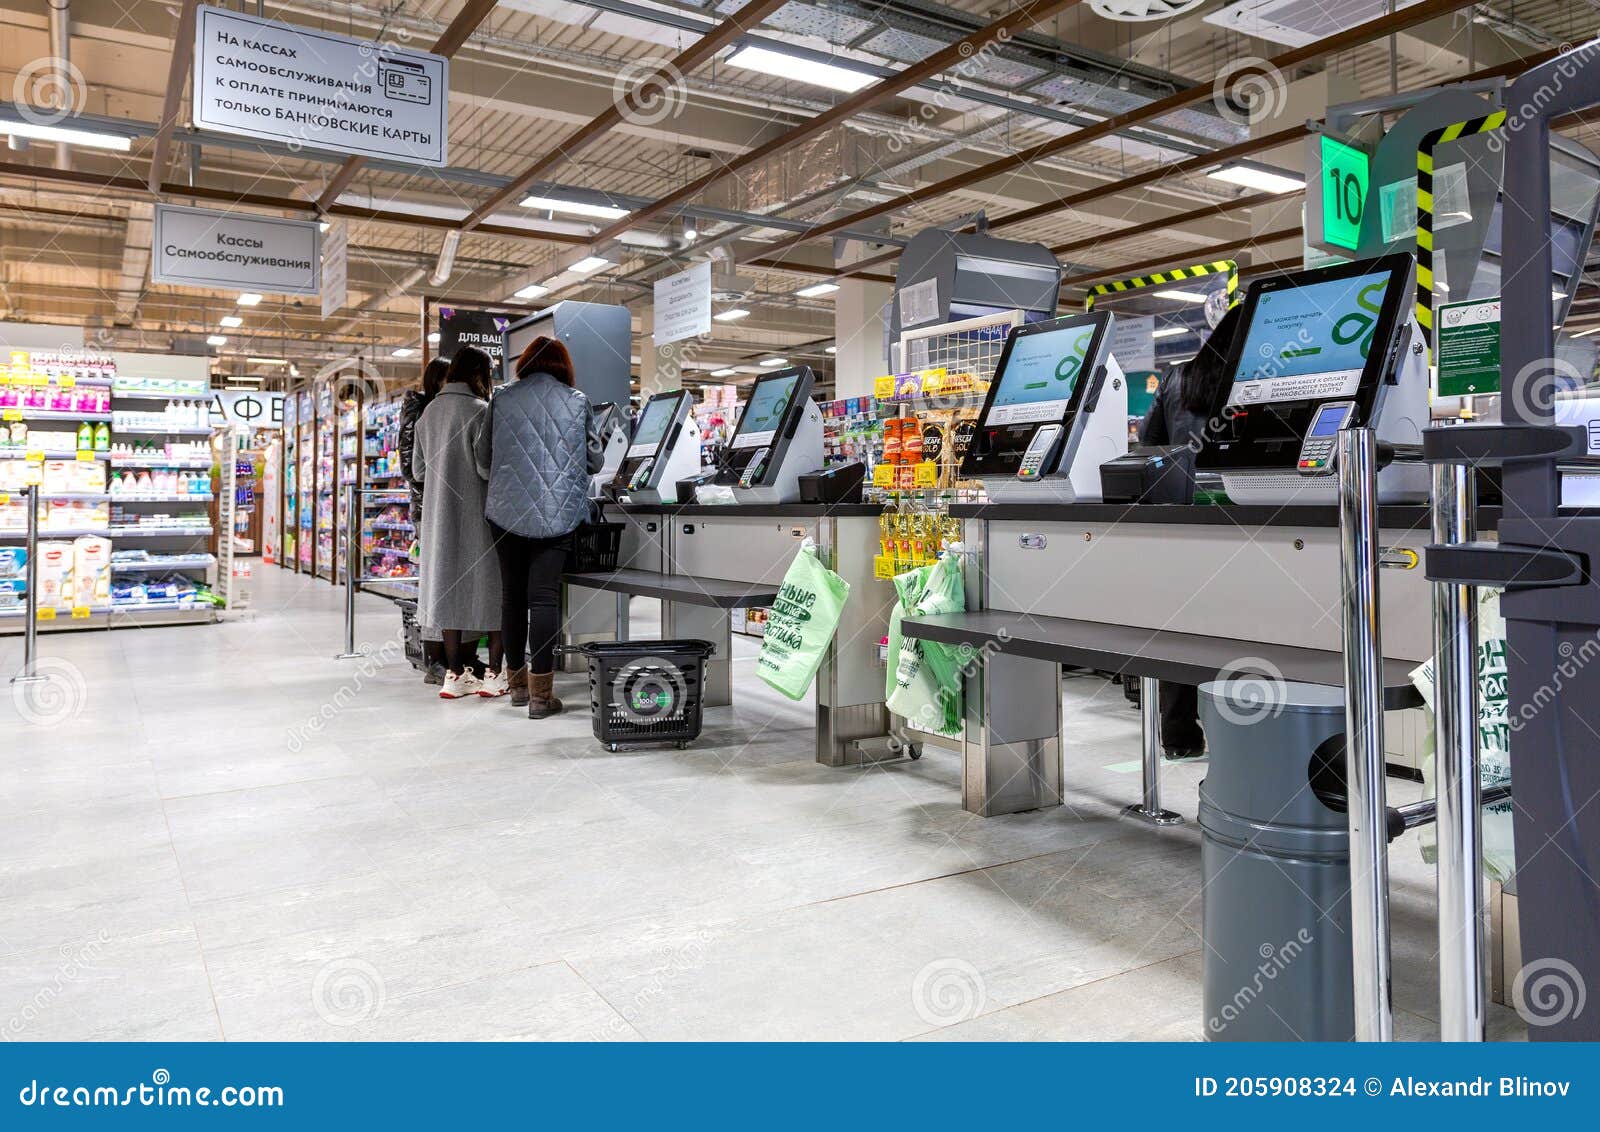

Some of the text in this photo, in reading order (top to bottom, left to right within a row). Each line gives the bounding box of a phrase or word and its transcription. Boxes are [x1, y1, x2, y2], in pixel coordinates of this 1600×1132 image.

[243, 39, 297, 59] КАССАХ
[216, 55, 372, 95] САМООБСЛУЖИВАНИЯ
[216, 76, 393, 118] К ОПЛАТЕ ПРИНИМАЮТСЯ
[215, 98, 431, 145] ТОЛЬКО БАНКОВСКИЕ КАРТЫ
[1330, 168, 1362, 226] 10
[216, 233, 263, 249] Кассы
[165, 244, 311, 270] Самообслуживания
[458, 332, 502, 344] ДЛЯ ВАШ
[209, 394, 283, 422] АФЕ
